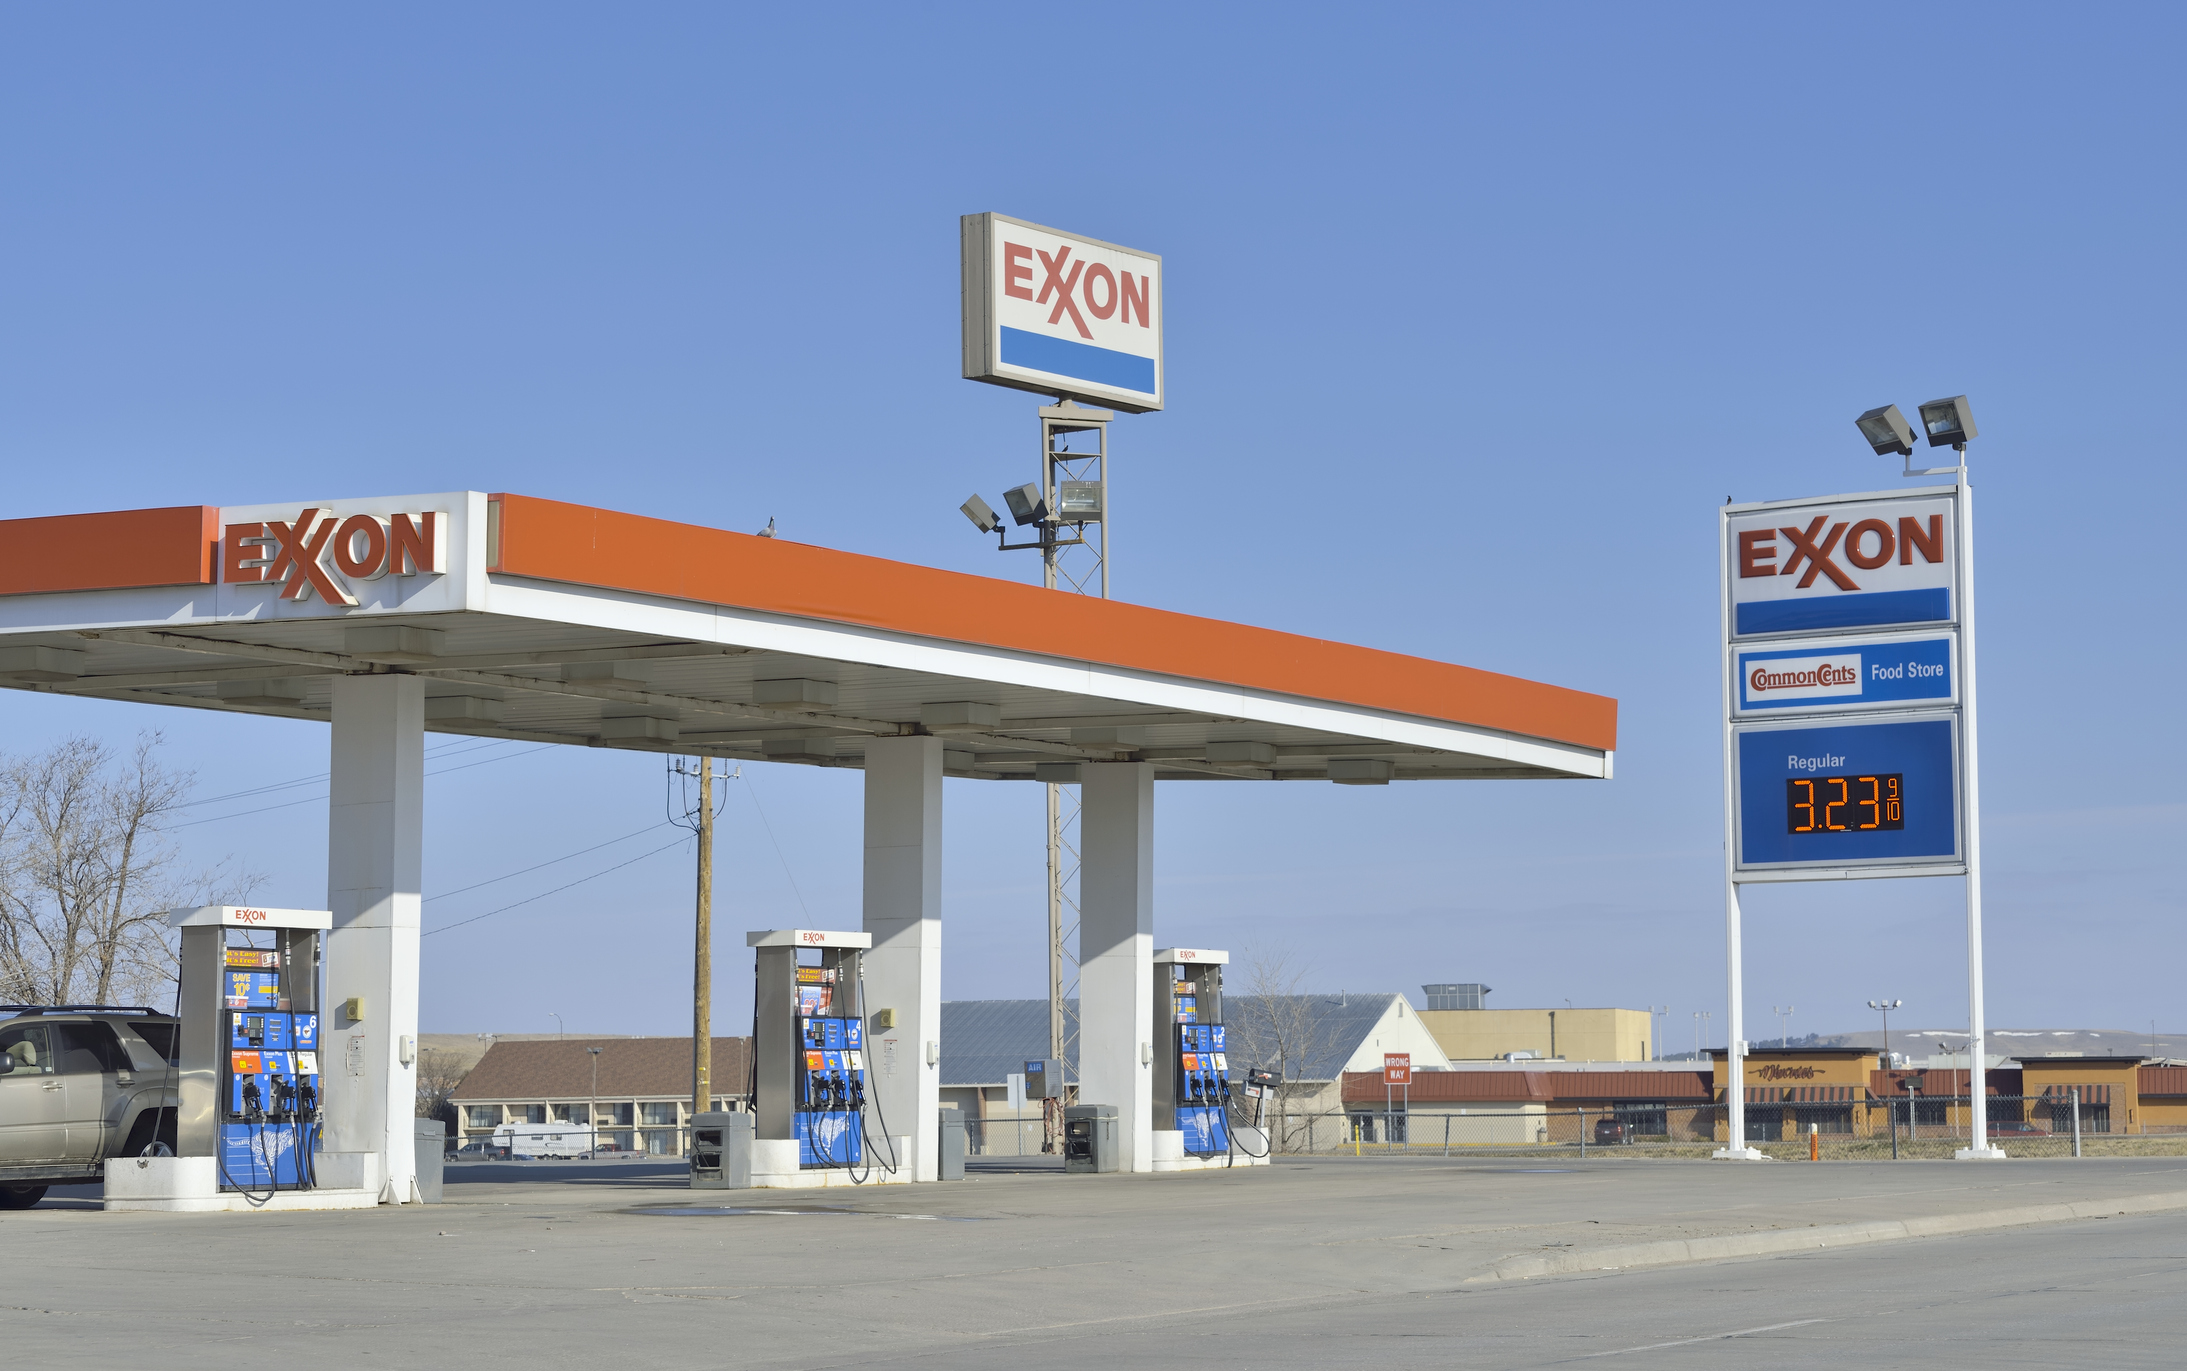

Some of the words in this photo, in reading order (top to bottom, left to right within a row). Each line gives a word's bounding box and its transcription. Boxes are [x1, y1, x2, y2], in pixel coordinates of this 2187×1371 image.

[1004, 241, 1149, 340] EXXON
[223, 508, 441, 606] EXXON
[1738, 514, 1944, 591] EXXON
[1871, 663, 1903, 680] Food
[1908, 661, 1944, 678] Store
[1788, 753, 1846, 772] Regular
[1794, 777, 1880, 832] 3.23
[236, 909, 266, 924] EXXON
[803, 932, 825, 944] EXXON
[1180, 950, 1195, 961] EXXON
[232, 973, 251, 982] SAVE
[309, 1015, 317, 1029] 6
[856, 1020, 861, 1031] 4
[1220, 1026, 1225, 1036] 2
[1028, 1063, 1042, 1071] AIR
[1385, 1057, 1409, 1067] WRONG
[1390, 1069, 1405, 1079] WAY
